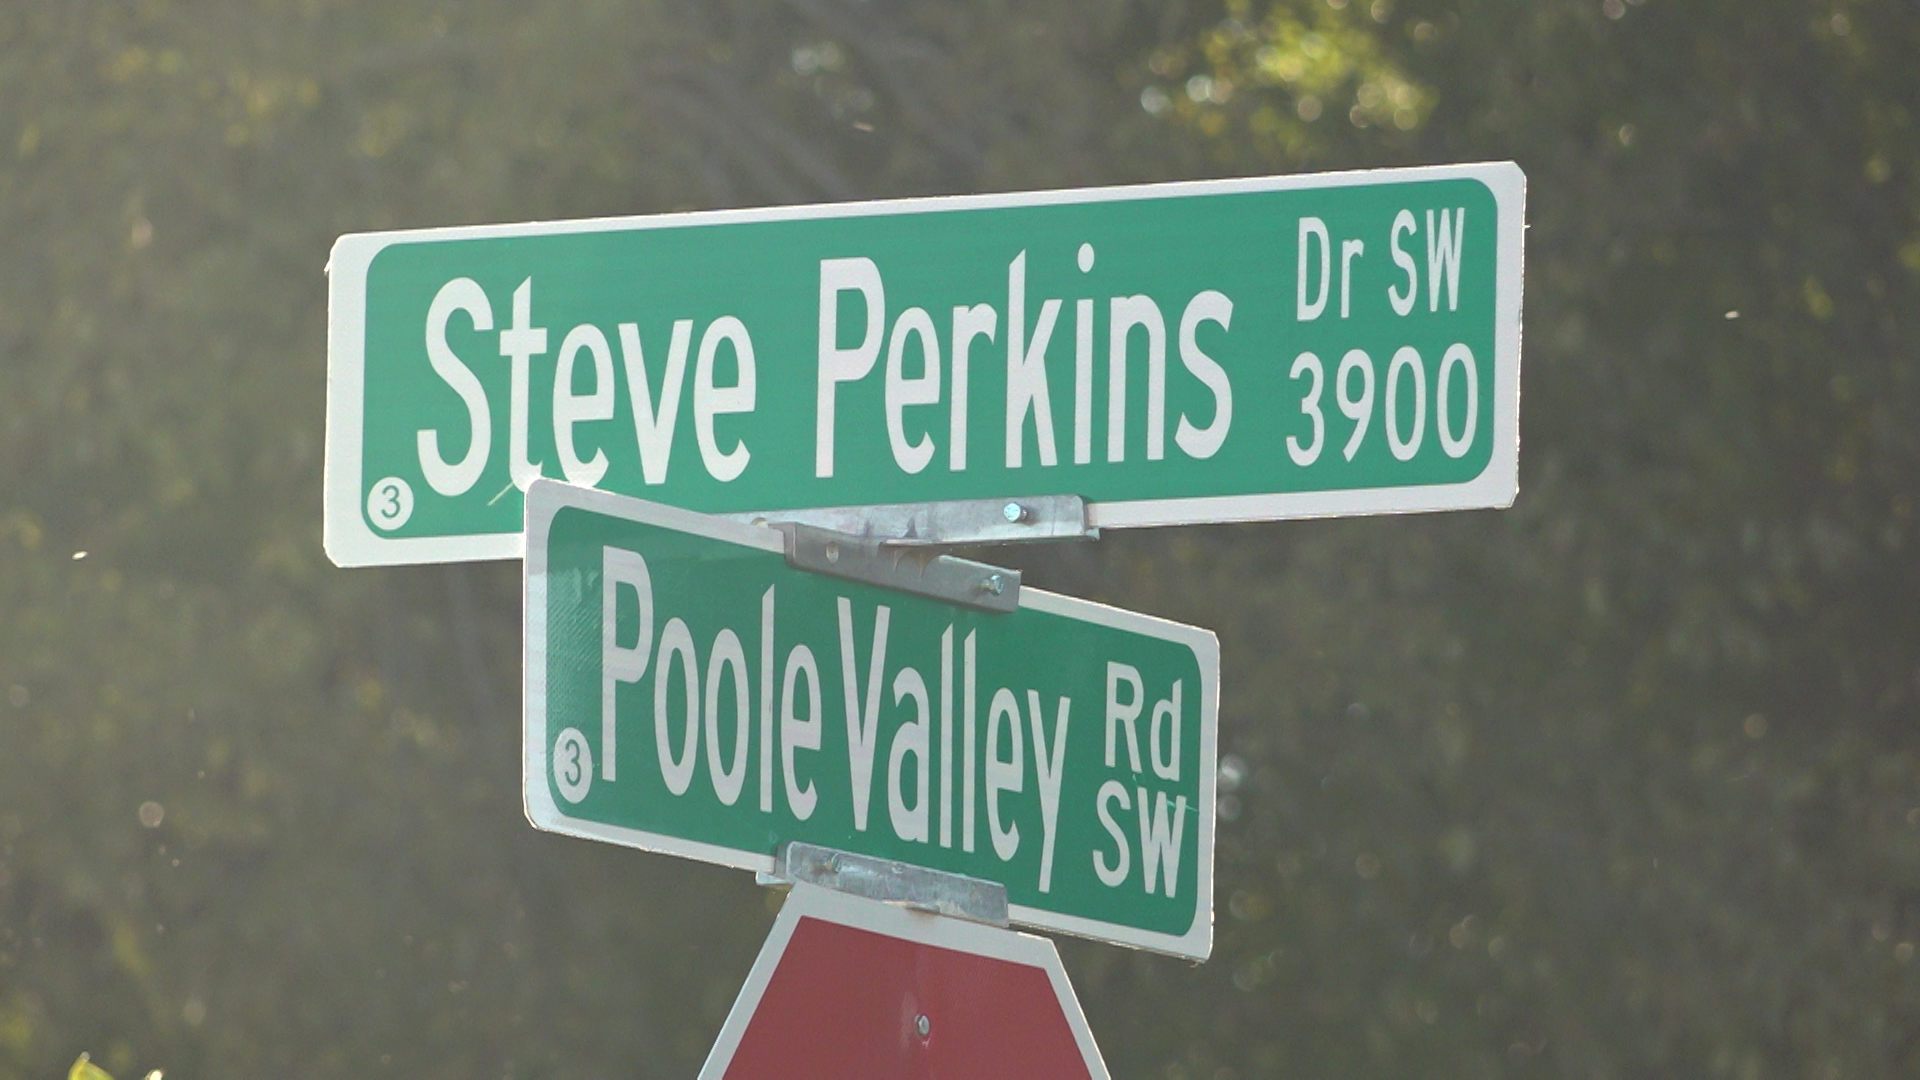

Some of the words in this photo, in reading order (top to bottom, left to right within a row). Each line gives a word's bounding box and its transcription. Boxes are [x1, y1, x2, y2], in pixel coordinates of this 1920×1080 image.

[1296, 215, 1365, 323] Dr
[1387, 206, 1466, 317] SW
[415, 275, 757, 498] Steve
[814, 241, 1235, 479] Perkins
[1285, 342, 1479, 468] 3900
[379, 483, 401, 520] 3
[563, 737, 583, 788] 3
[601, 544, 822, 822] Poole
[836, 595, 1072, 894] Valley
[1104, 660, 1182, 783] Rd
[1092, 780, 1188, 899] SW
